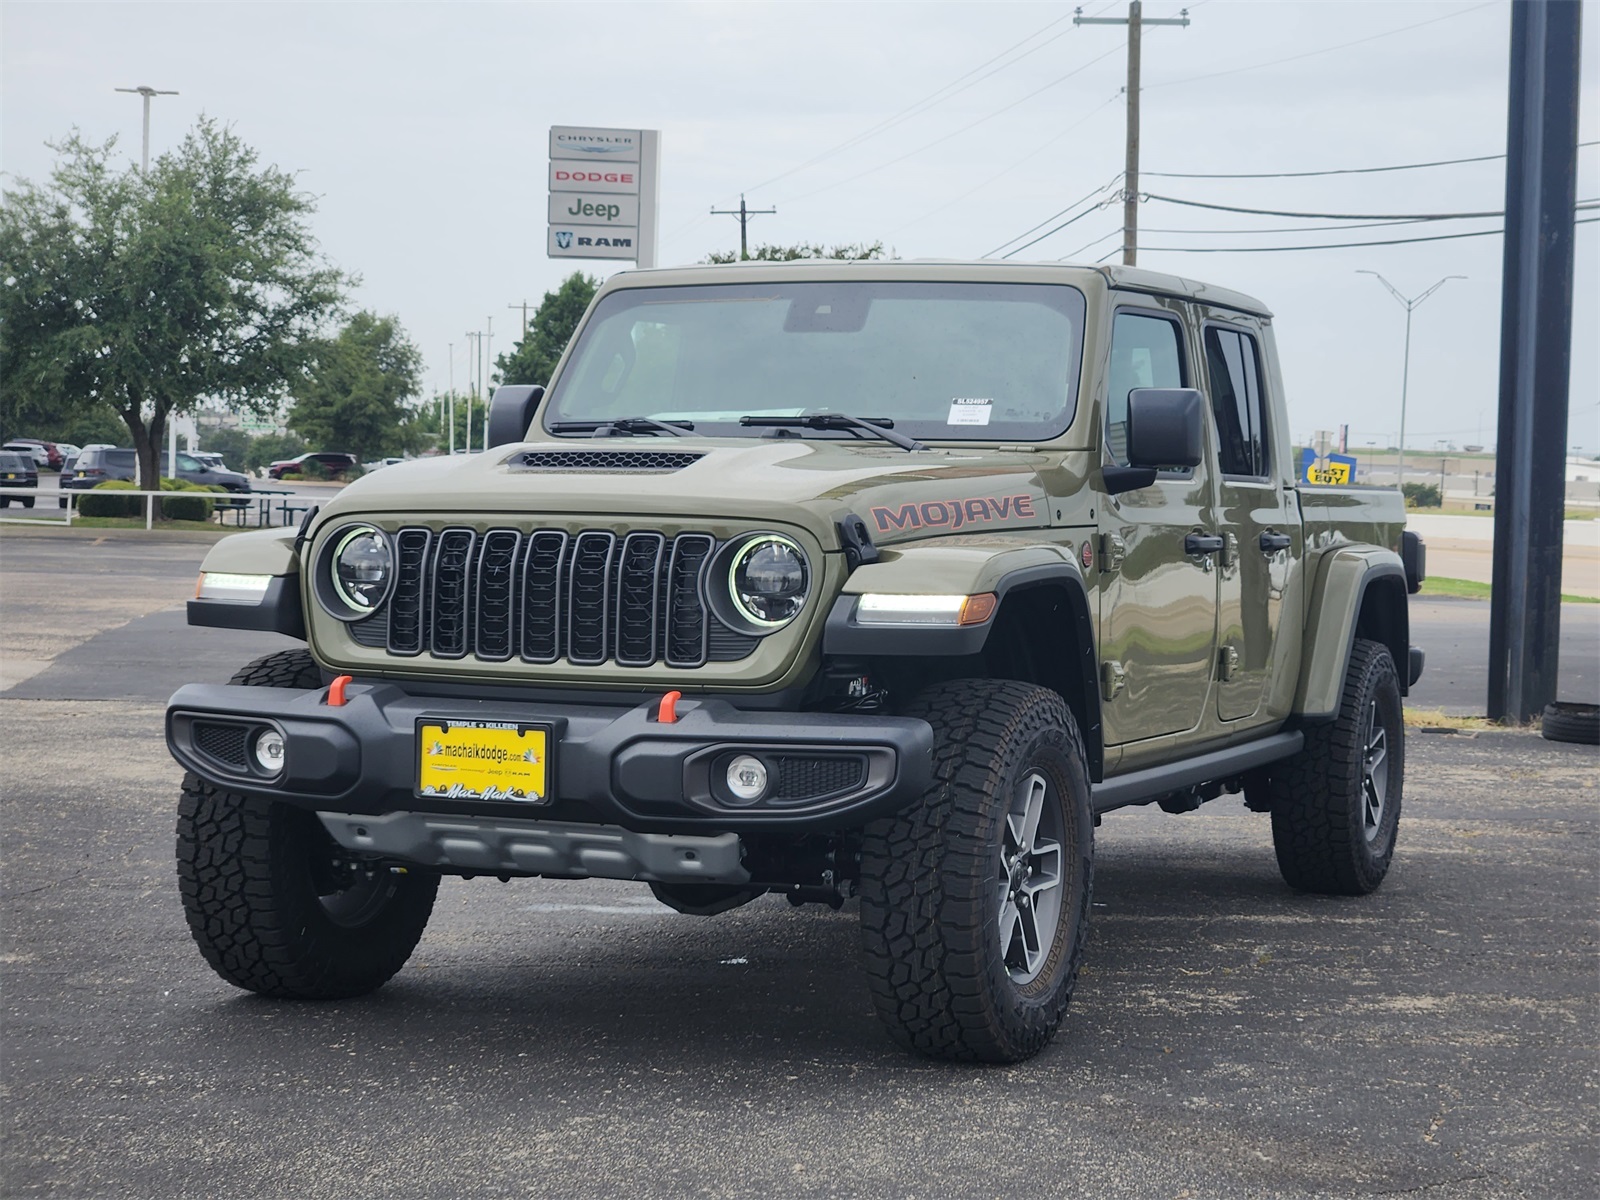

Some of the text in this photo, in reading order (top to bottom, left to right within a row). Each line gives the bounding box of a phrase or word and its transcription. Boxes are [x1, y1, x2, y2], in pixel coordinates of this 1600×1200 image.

[557, 134, 633, 144] CHRYSLER
[555, 171, 634, 184] DODGE
[567, 198, 621, 221] Jeep
[577, 237, 632, 248] RAM
[1314, 474, 1342, 484] BUY
[870, 494, 1036, 533] MOJAVE
[445, 720, 519, 730] TEMPLE KILLEEN
[444, 743, 522, 764] machaikdodge.com
[446, 783, 481, 799] Mac
